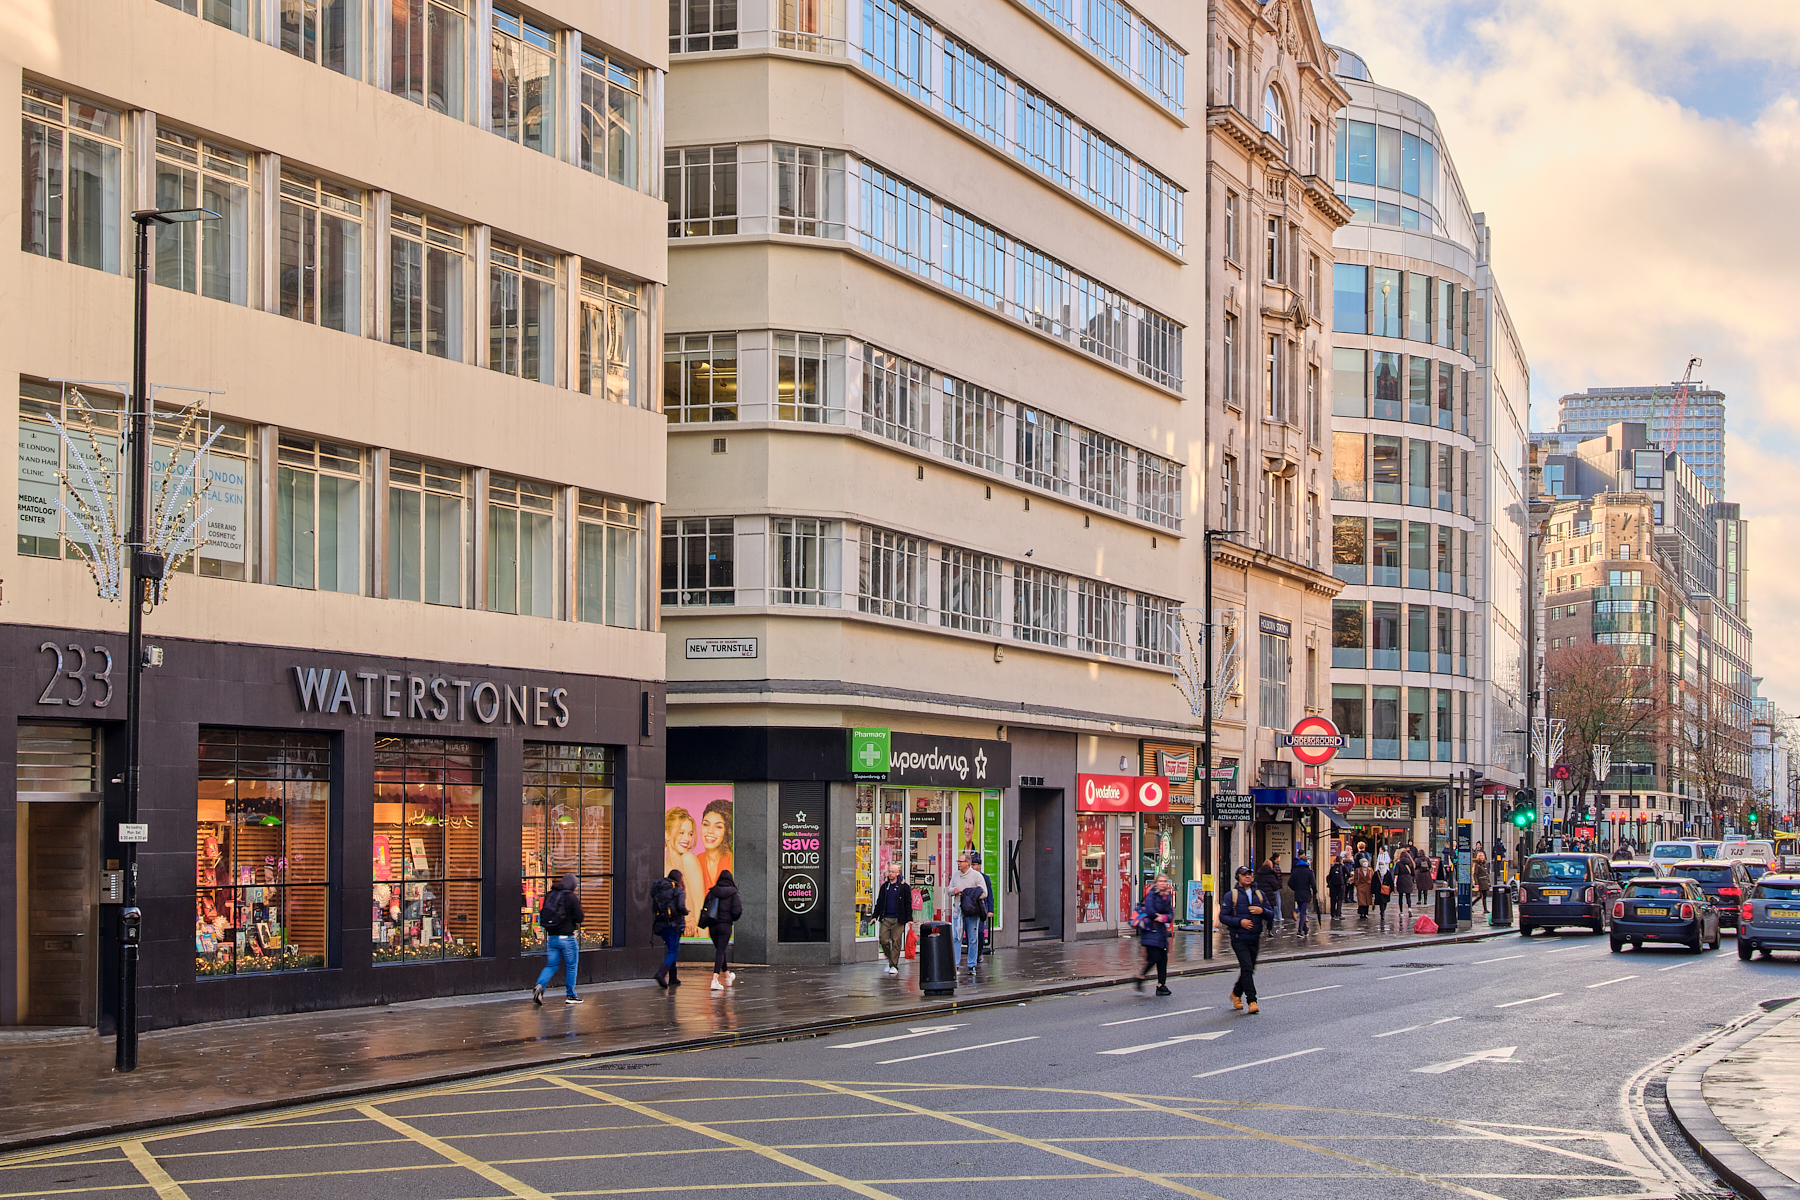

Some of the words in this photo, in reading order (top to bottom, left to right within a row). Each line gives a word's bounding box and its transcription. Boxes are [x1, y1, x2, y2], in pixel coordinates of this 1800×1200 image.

[1584, 396, 1640, 407] CENTRE
[26, 443, 56, 453] LONDON
[25, 456, 40, 464] AND
[42, 459, 58, 467] HAIR
[22, 468, 44, 477] CLINIC
[202, 469, 244, 486] LONDON
[19, 494, 47, 504] MEDICAL
[224, 492, 243, 505] SKIN
[18, 504, 57, 516] RMATOLOGY
[20, 514, 46, 524] CENTER
[207, 521, 225, 530] LASER
[226, 524, 237, 532] AND
[208, 530, 236, 540] COSMETIC
[1260, 618, 1276, 632] HOLBORN
[1276, 622, 1289, 634] STATION
[711, 644, 753, 652] TURNSTILE
[37, 641, 114, 708] 233
[294, 665, 570, 728] WATERSTONES
[855, 731, 886, 739] Pharmacy
[1286, 736, 1343, 746] UNDERGROUND
[890, 746, 970, 780] uperdrug
[1095, 785, 1120, 799] vodafone
[1355, 794, 1401, 808] insbury's
[1374, 806, 1400, 819] Local
[782, 823, 819, 831] Superdrug
[782, 838, 820, 851] save
[782, 852, 820, 864] more
[1006, 840, 1021, 893] K
[788, 889, 812, 897] collect
